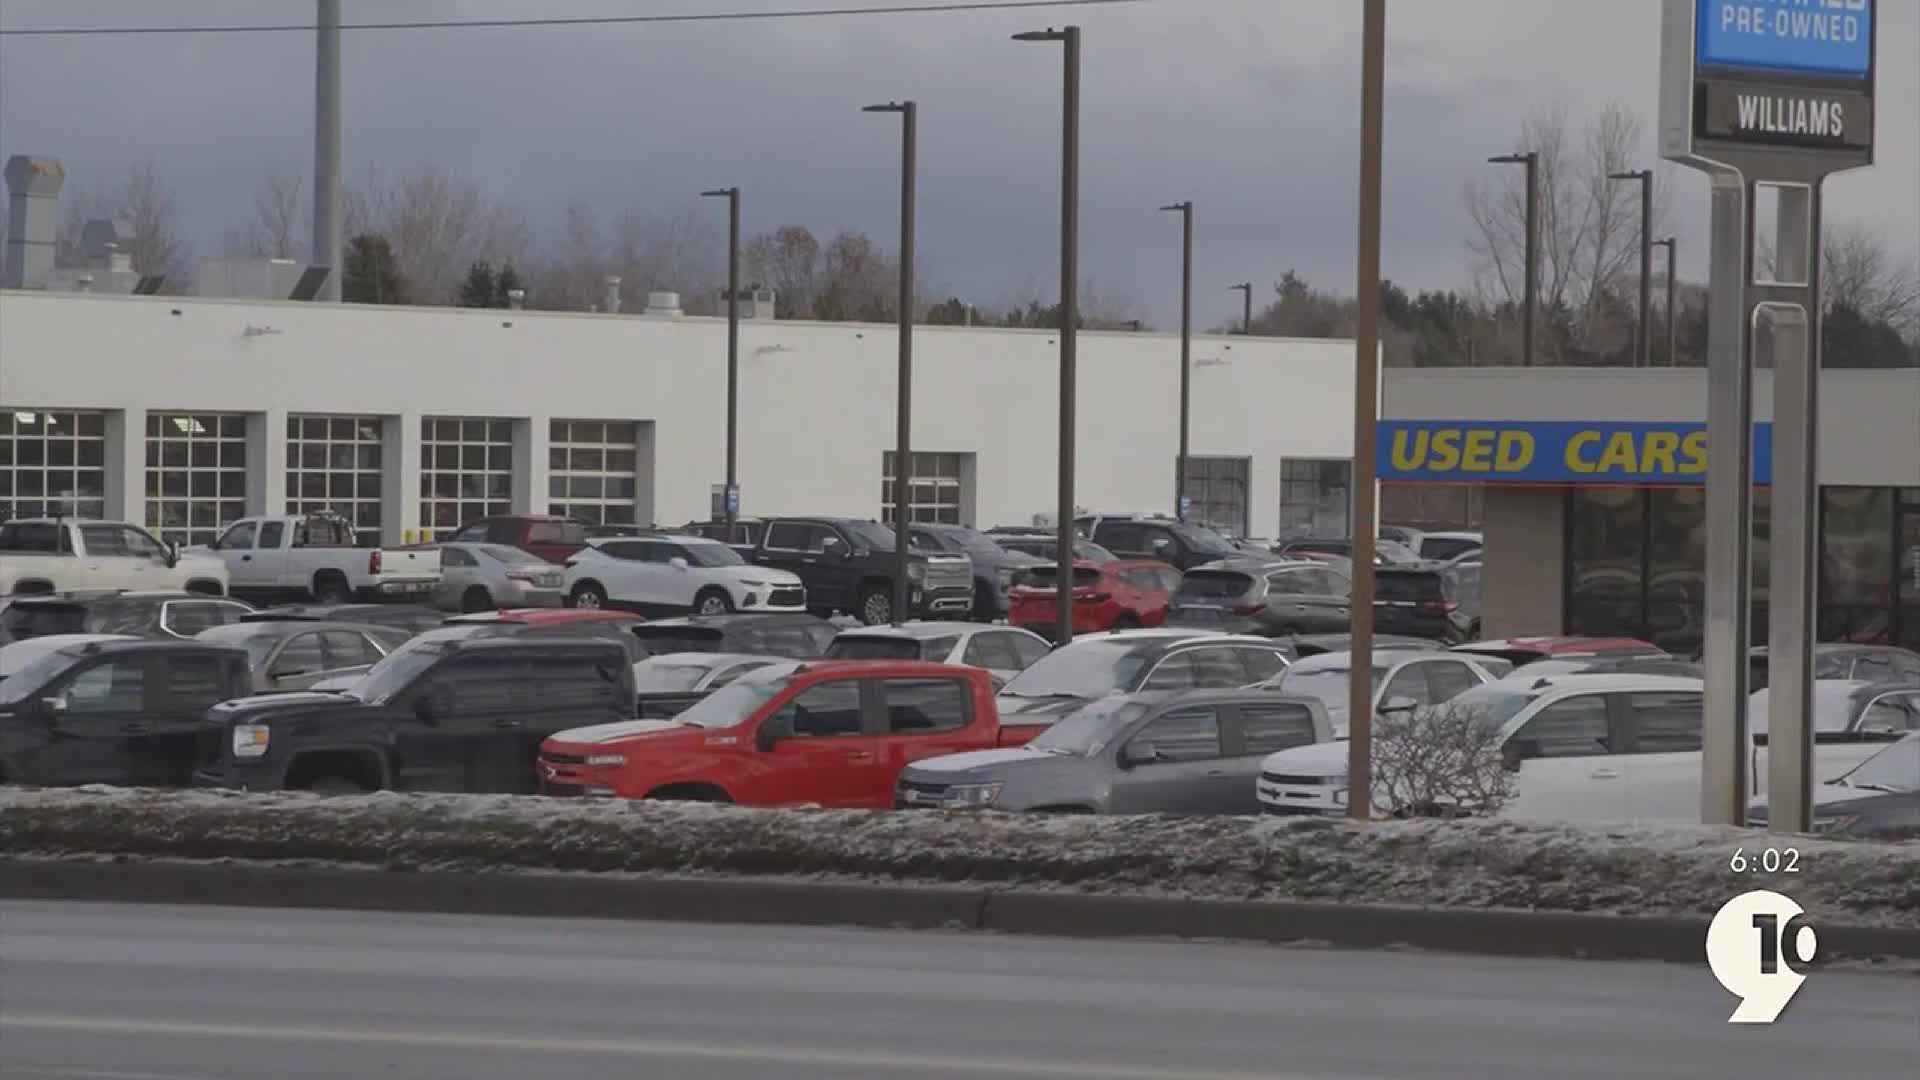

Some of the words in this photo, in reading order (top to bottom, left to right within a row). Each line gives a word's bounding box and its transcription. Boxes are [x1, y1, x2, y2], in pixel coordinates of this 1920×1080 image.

[1721, 4, 1858, 42] PRE-OWNED
[1737, 94, 1844, 137] WILLIAMS
[1391, 429, 1536, 472] USED
[1564, 430, 1707, 475] CARS
